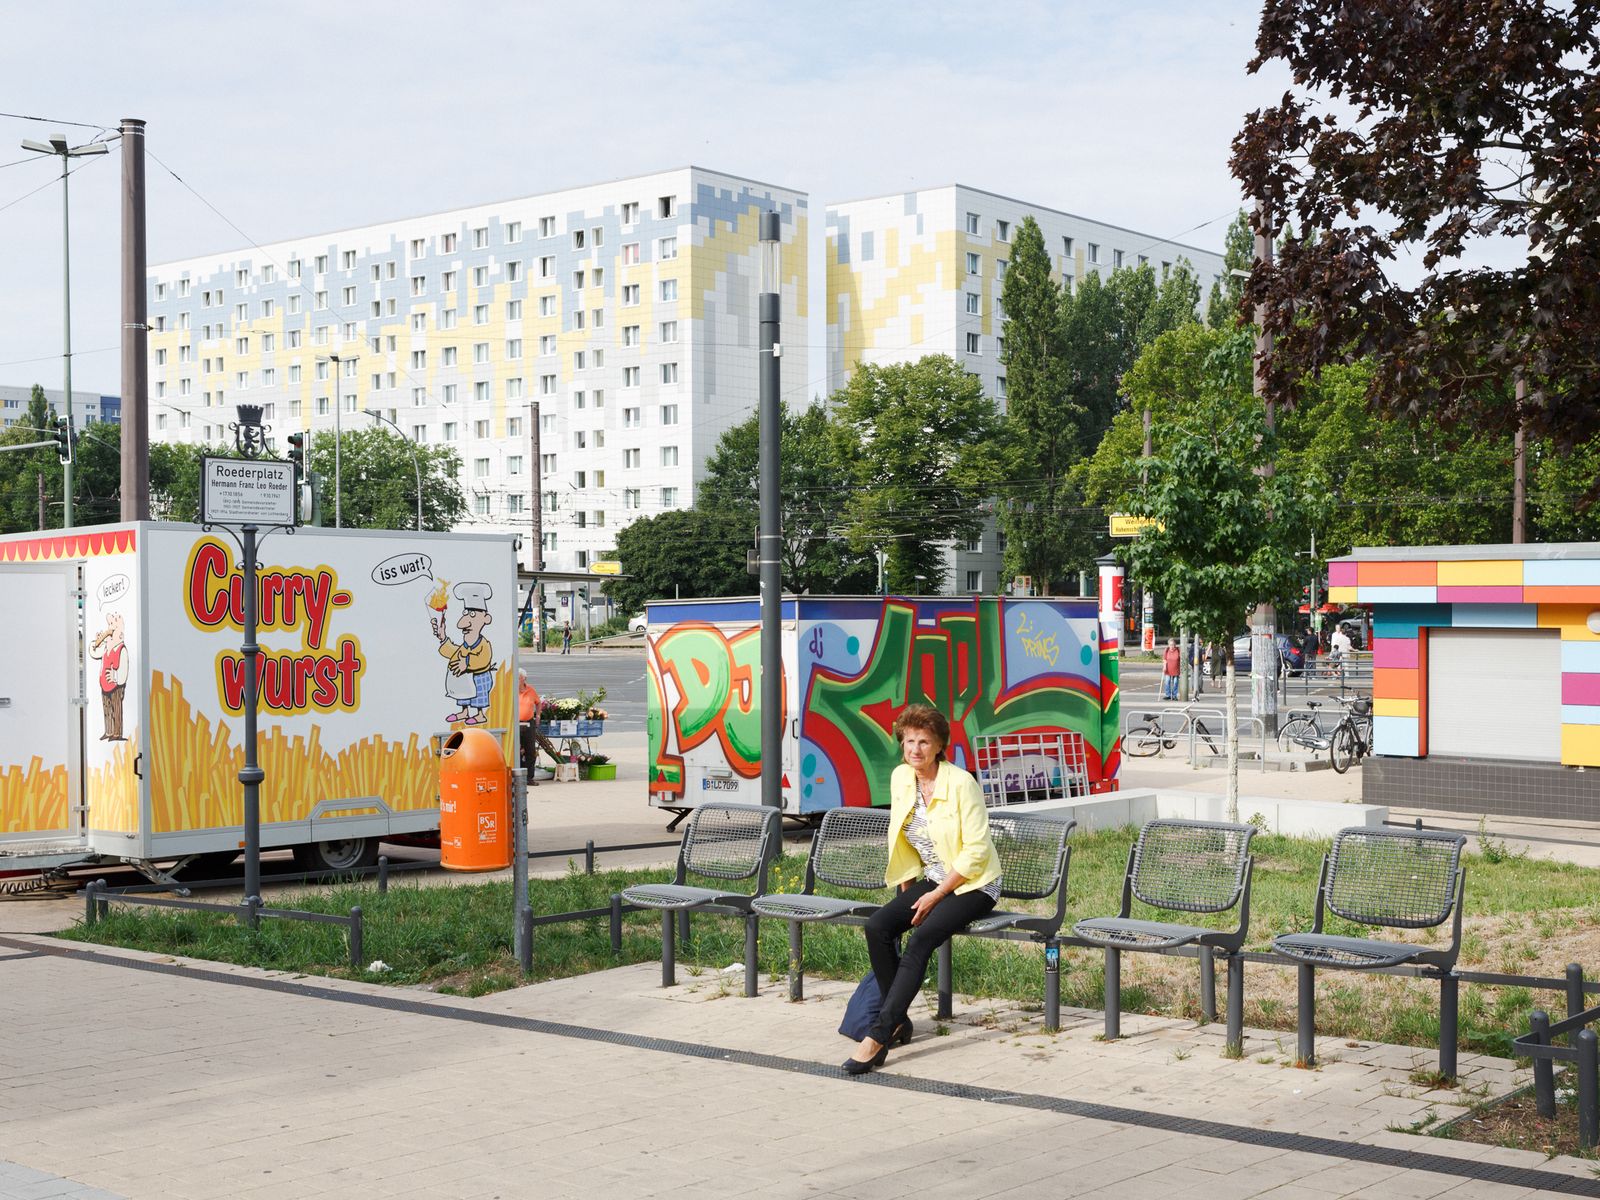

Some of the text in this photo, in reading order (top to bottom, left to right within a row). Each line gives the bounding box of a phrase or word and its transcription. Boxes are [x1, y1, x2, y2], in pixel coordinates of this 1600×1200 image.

[216, 465, 283, 481] Roederplatz
[211, 479, 288, 491] Hermann Franz Leo Roeder
[380, 557, 426, 581] iss wat!
[102, 577, 125, 598] lecker!
[190, 541, 351, 650] Curry-
[808, 627, 824, 660] dj
[221, 640, 362, 710] wurst
[722, 781, 738, 790] 7099
[479, 815, 495, 829] BSR
